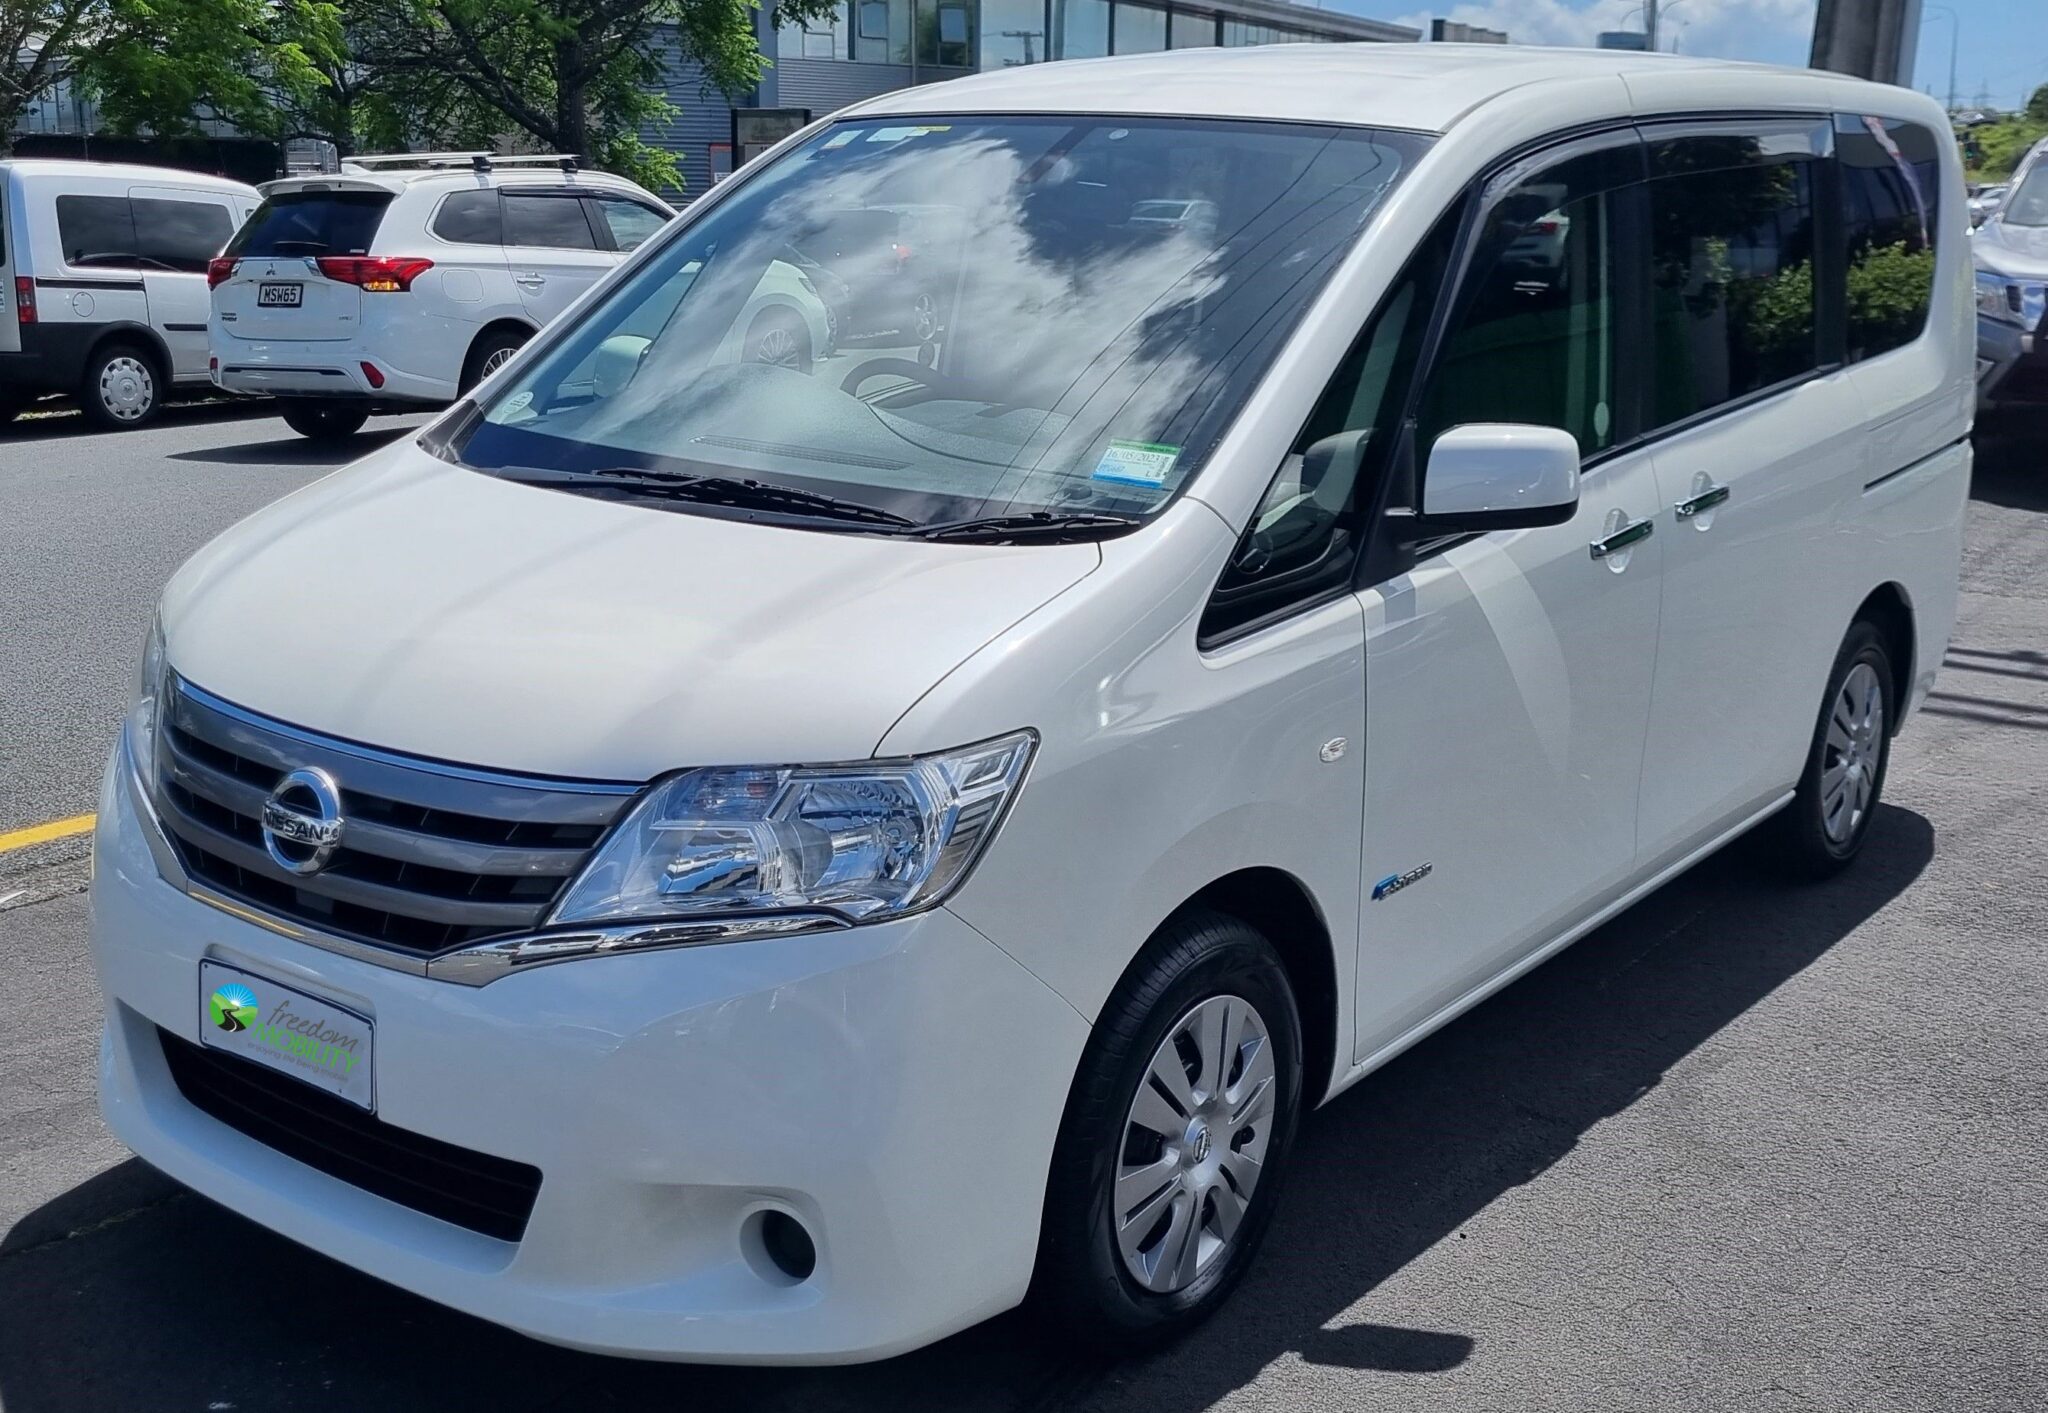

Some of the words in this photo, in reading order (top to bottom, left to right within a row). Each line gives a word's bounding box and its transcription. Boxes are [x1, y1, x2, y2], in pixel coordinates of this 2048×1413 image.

[264, 287, 297, 302] MSW65
[263, 806, 325, 840] NISSAN
[266, 1000, 359, 1052] freedom
[252, 1023, 362, 1073] MOBILITY
